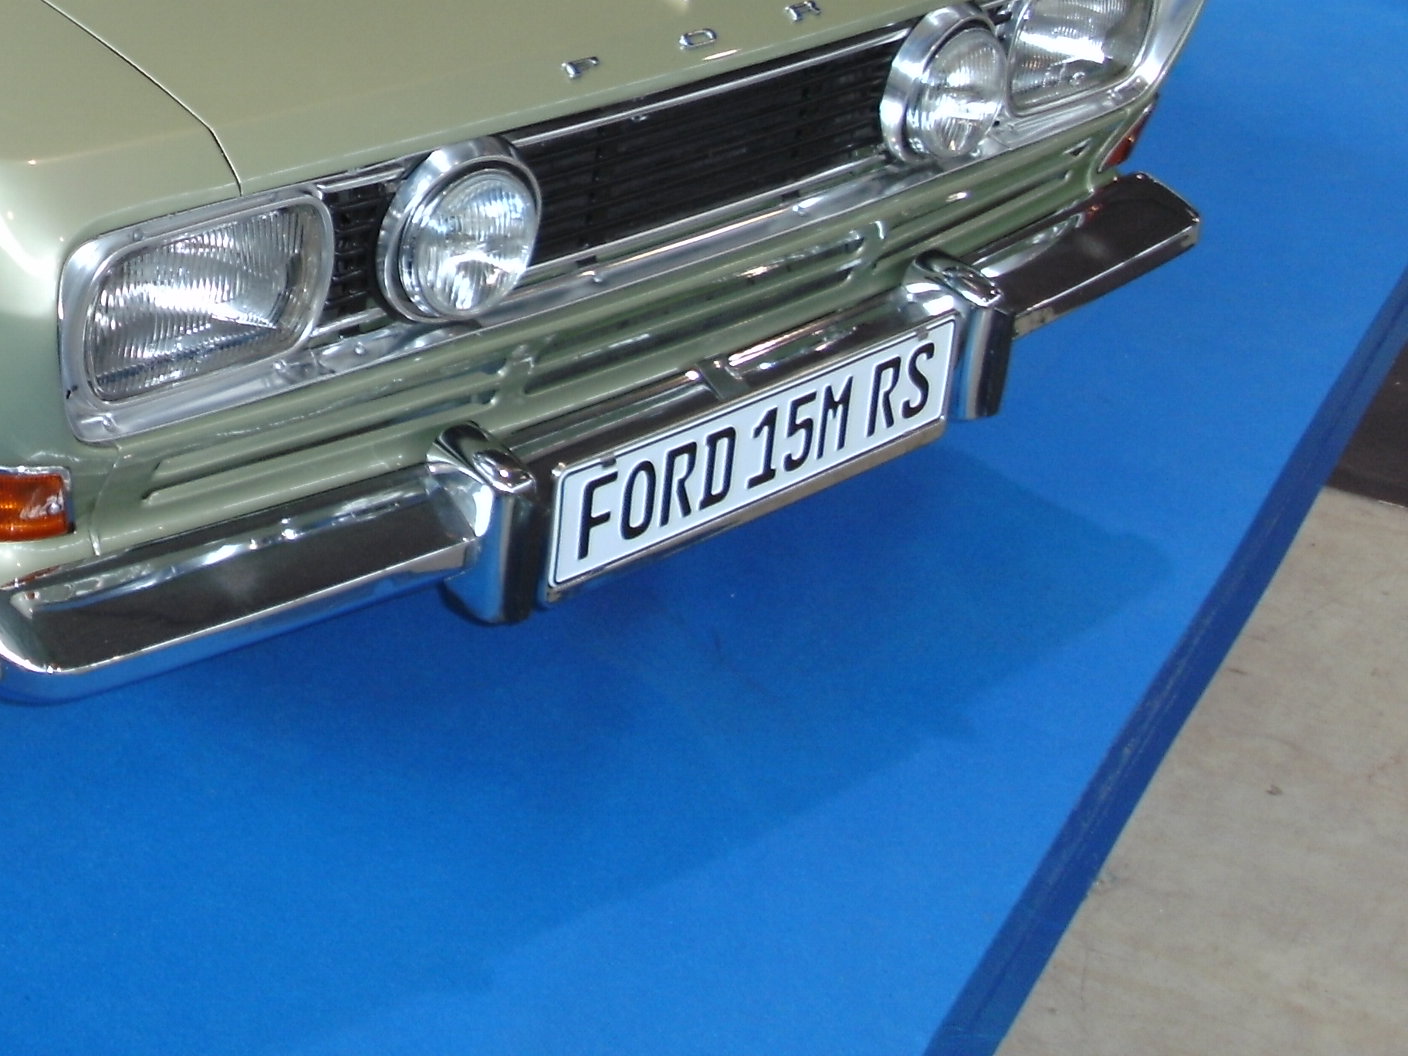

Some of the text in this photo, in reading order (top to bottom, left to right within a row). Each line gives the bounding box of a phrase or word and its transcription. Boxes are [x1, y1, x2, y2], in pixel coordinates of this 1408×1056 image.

[576, 342, 935, 561] FORD 15M RS
